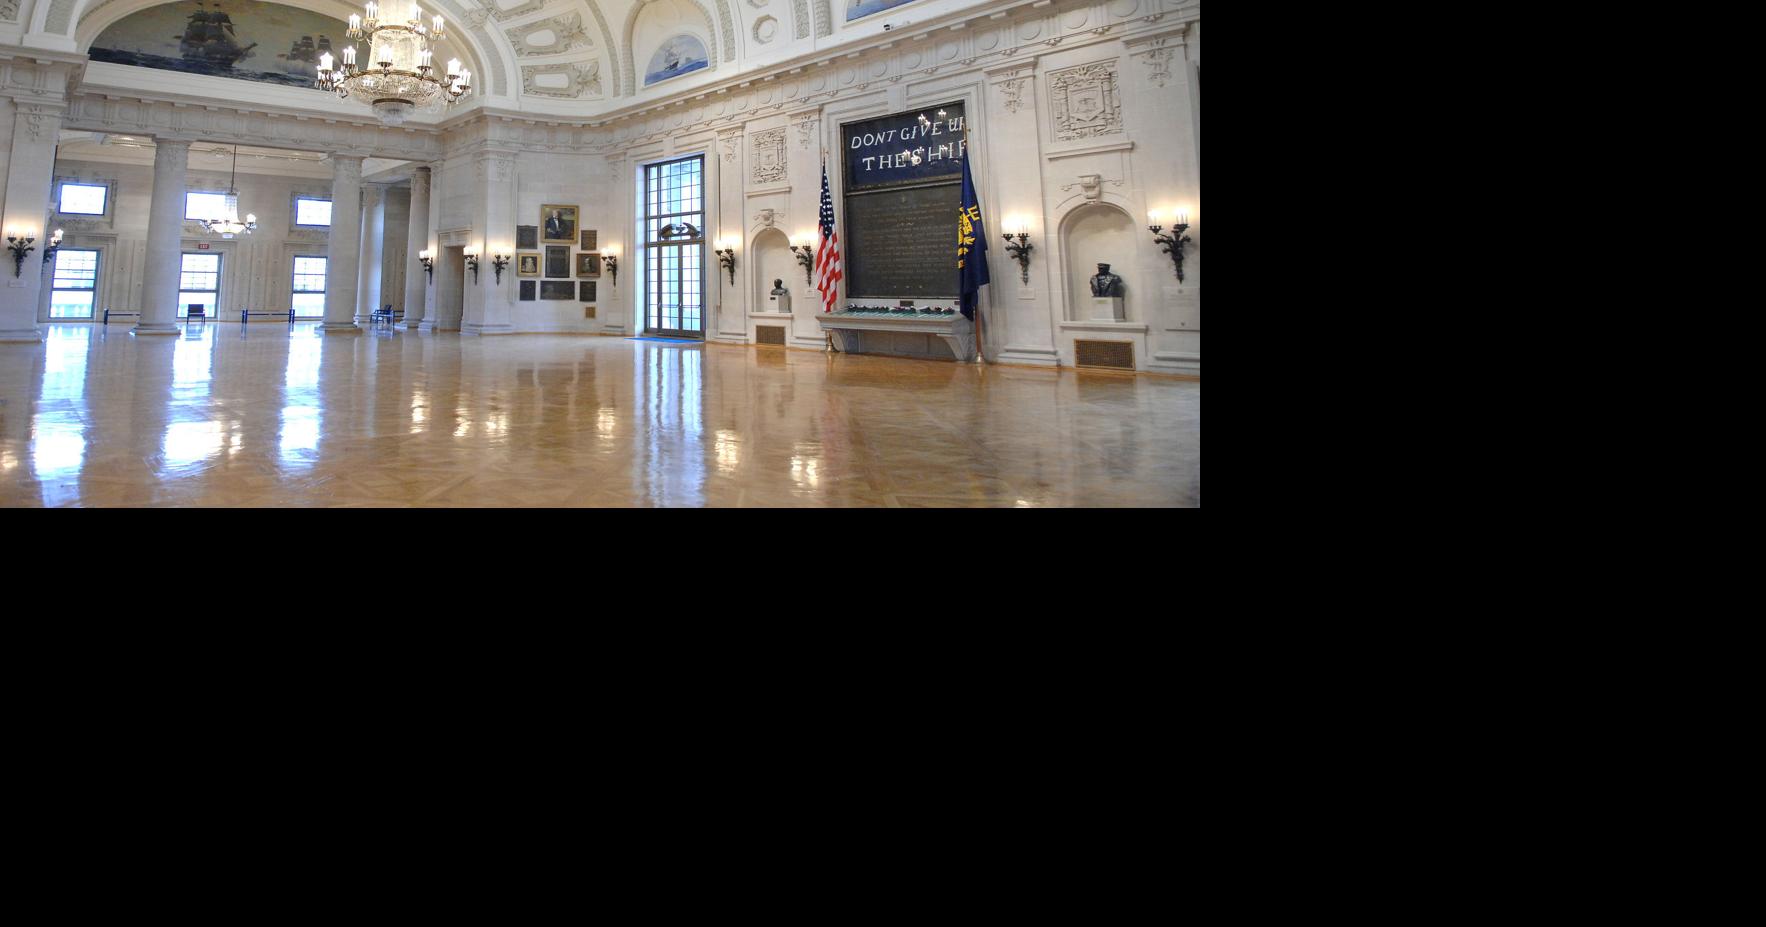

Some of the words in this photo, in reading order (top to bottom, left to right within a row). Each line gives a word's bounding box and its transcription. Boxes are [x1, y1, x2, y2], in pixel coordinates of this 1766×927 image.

[851, 129, 896, 149] DONT
[900, 121, 942, 141] GIVE
[862, 153, 907, 171] THE
